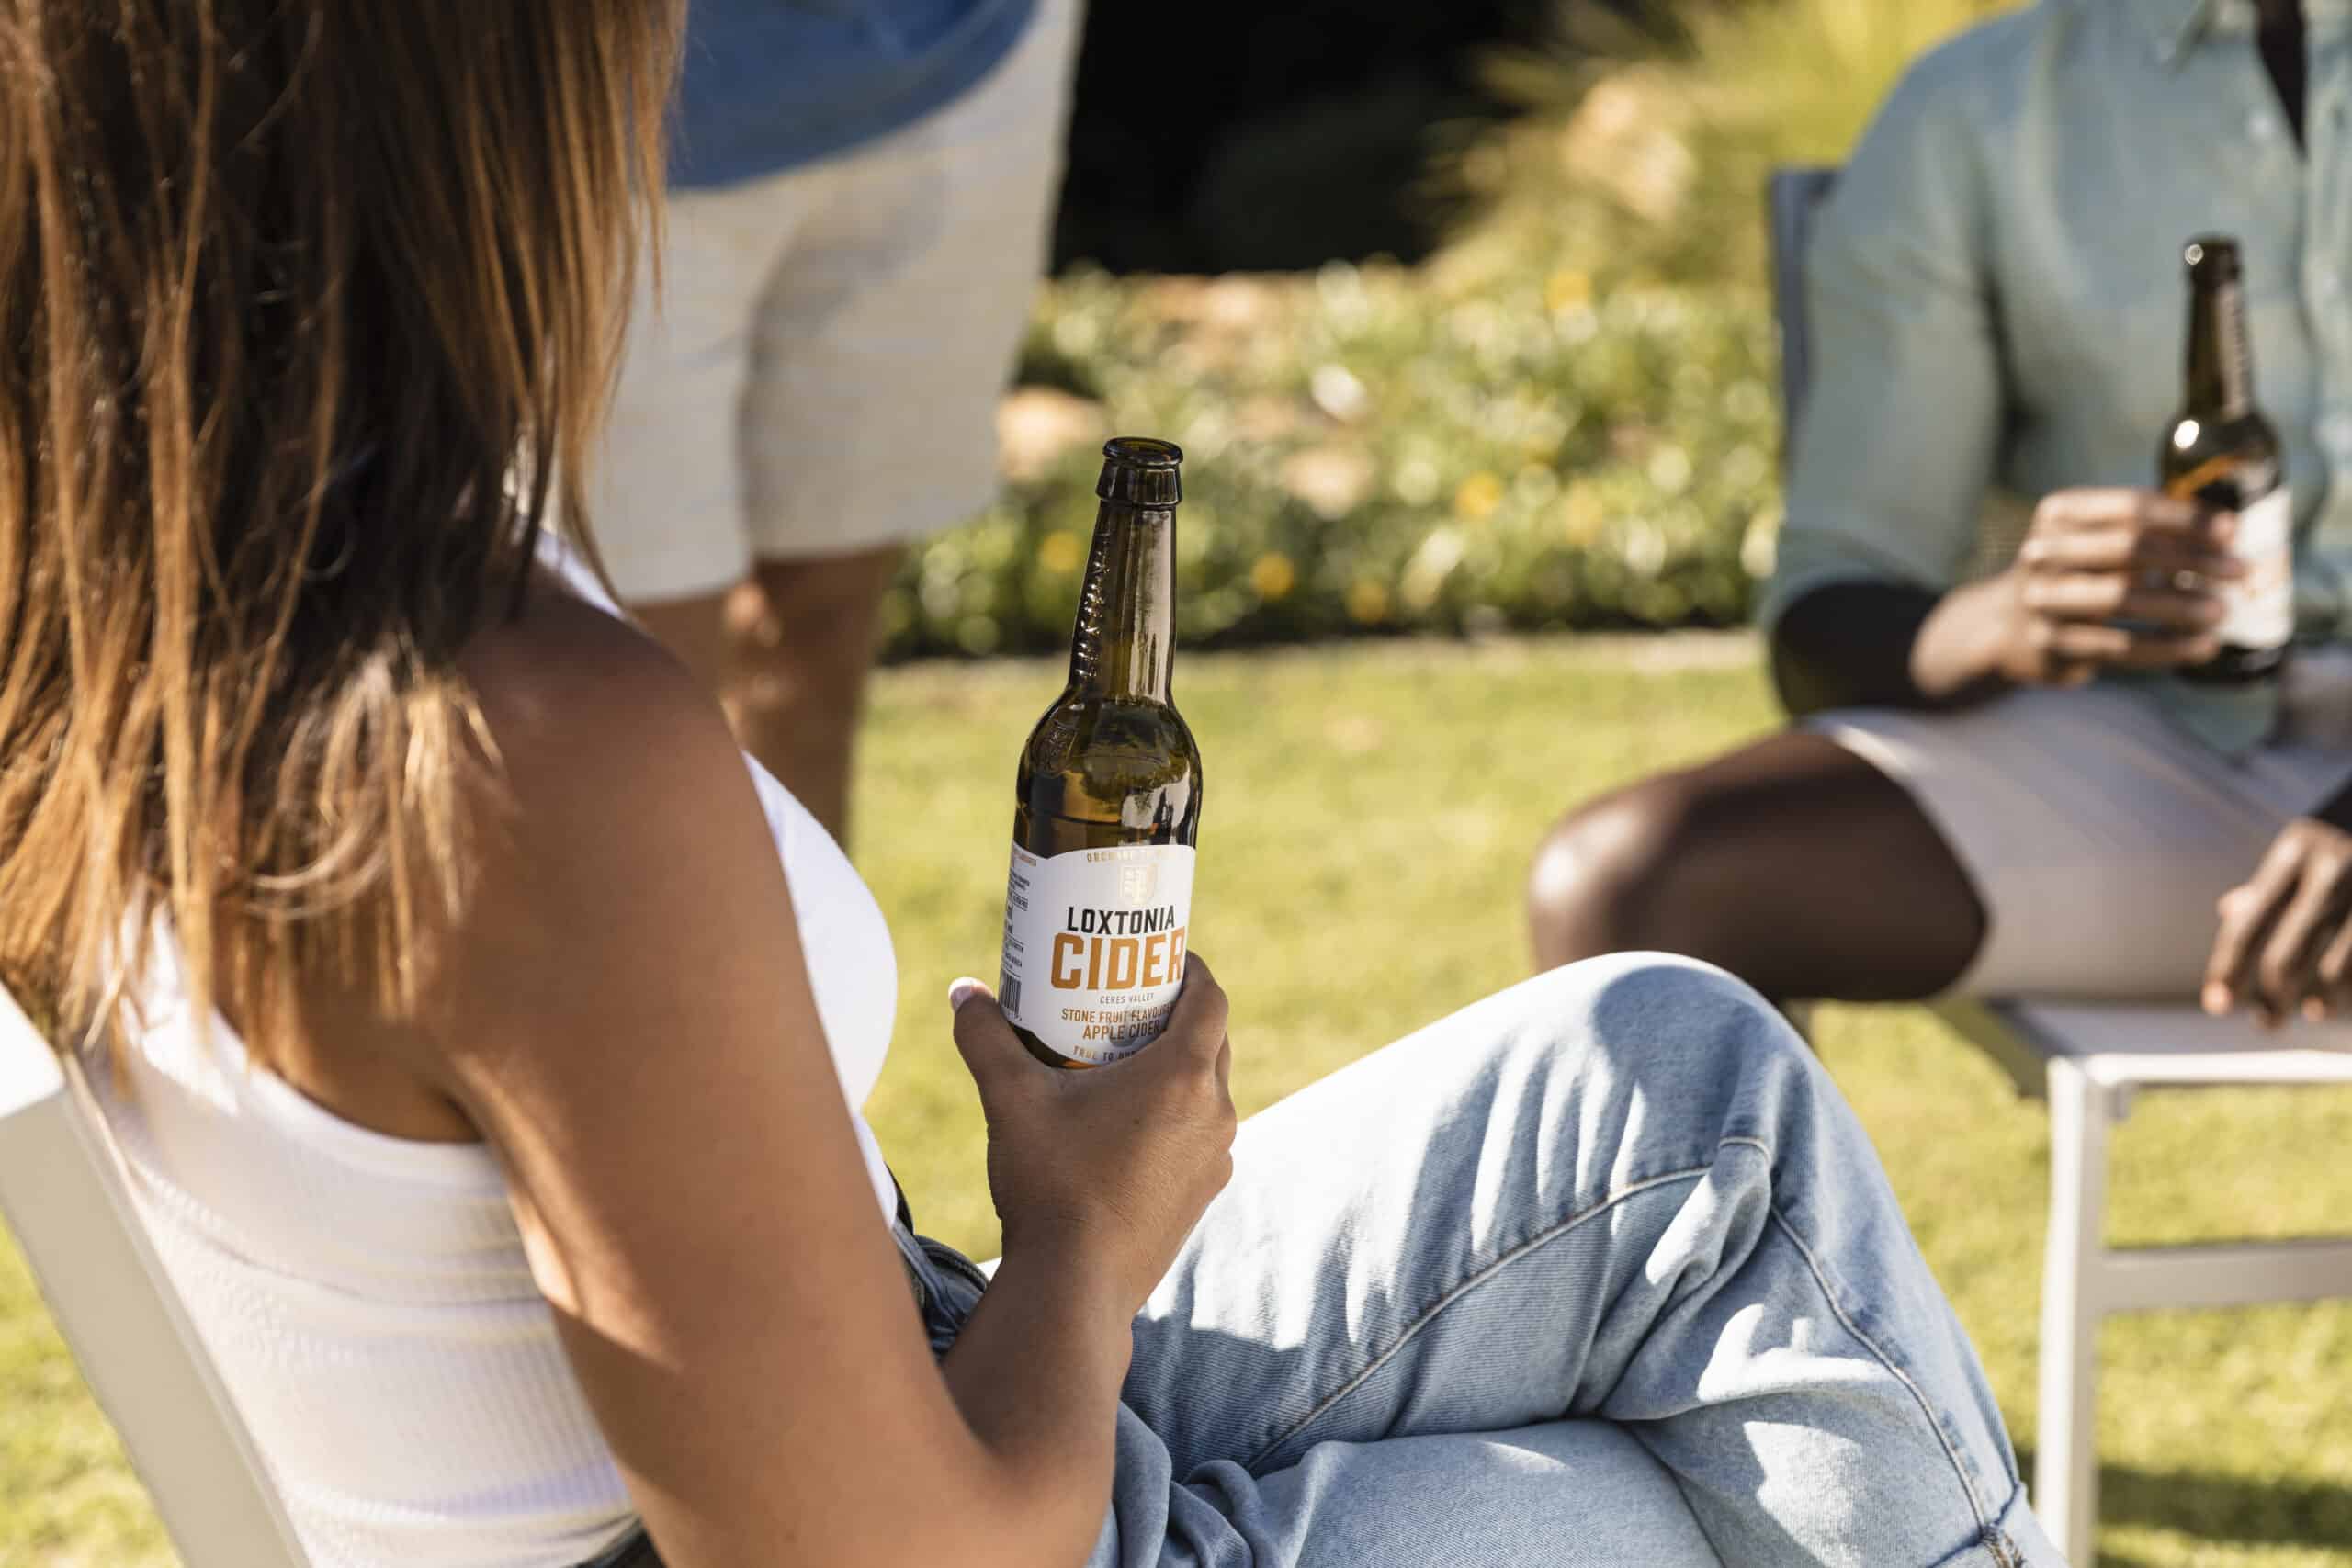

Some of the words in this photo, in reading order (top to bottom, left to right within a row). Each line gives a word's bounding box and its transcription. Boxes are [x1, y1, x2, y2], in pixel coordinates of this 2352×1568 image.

[1067, 906, 1176, 935] LOXTONIA
[1050, 925, 1186, 991] CIDER
[1099, 995, 1126, 1005] CERES
[1061, 1008, 1096, 1023] STONE
[1099, 1010, 1128, 1024] FRUIT
[1082, 1024, 1125, 1041] APPLE
[1128, 1020, 1161, 1038] CIDER
[1102, 1051, 1114, 1063] TO
